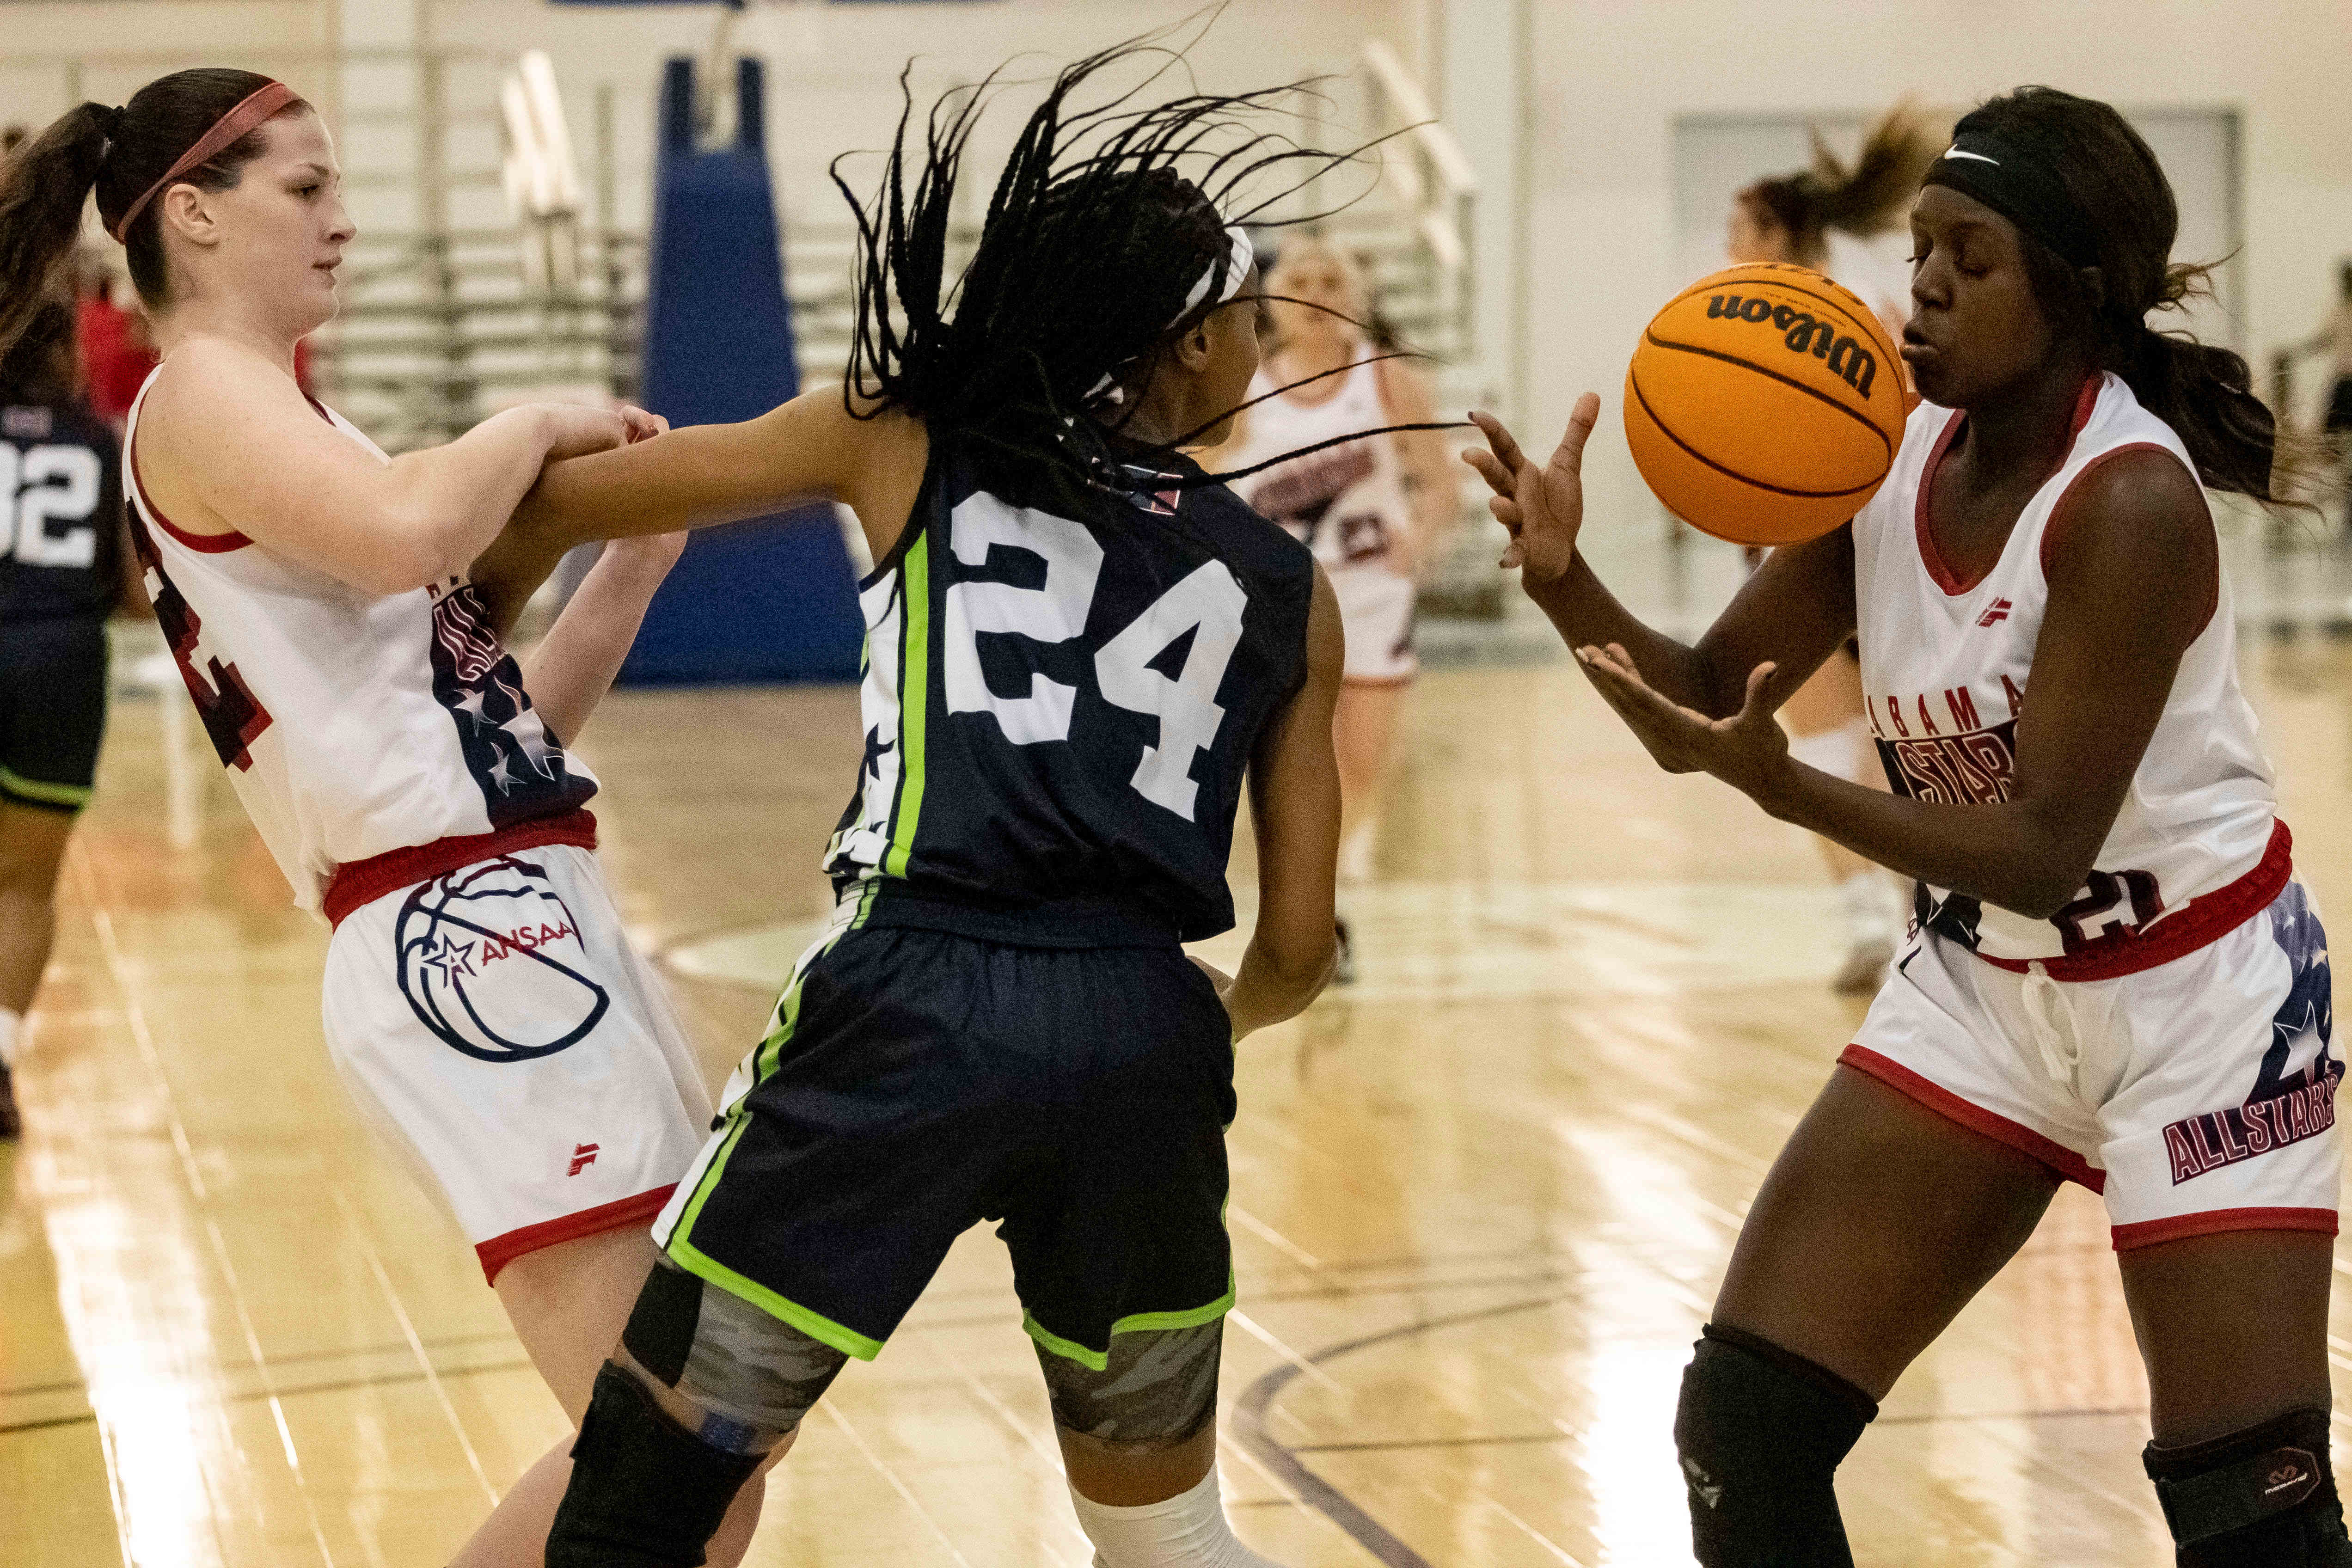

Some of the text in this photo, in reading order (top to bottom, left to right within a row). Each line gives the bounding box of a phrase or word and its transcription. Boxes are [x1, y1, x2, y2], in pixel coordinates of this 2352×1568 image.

[1706, 294, 1877, 401] Wilson
[0, 440, 102, 569] 2
[943, 490, 1249, 823] 24
